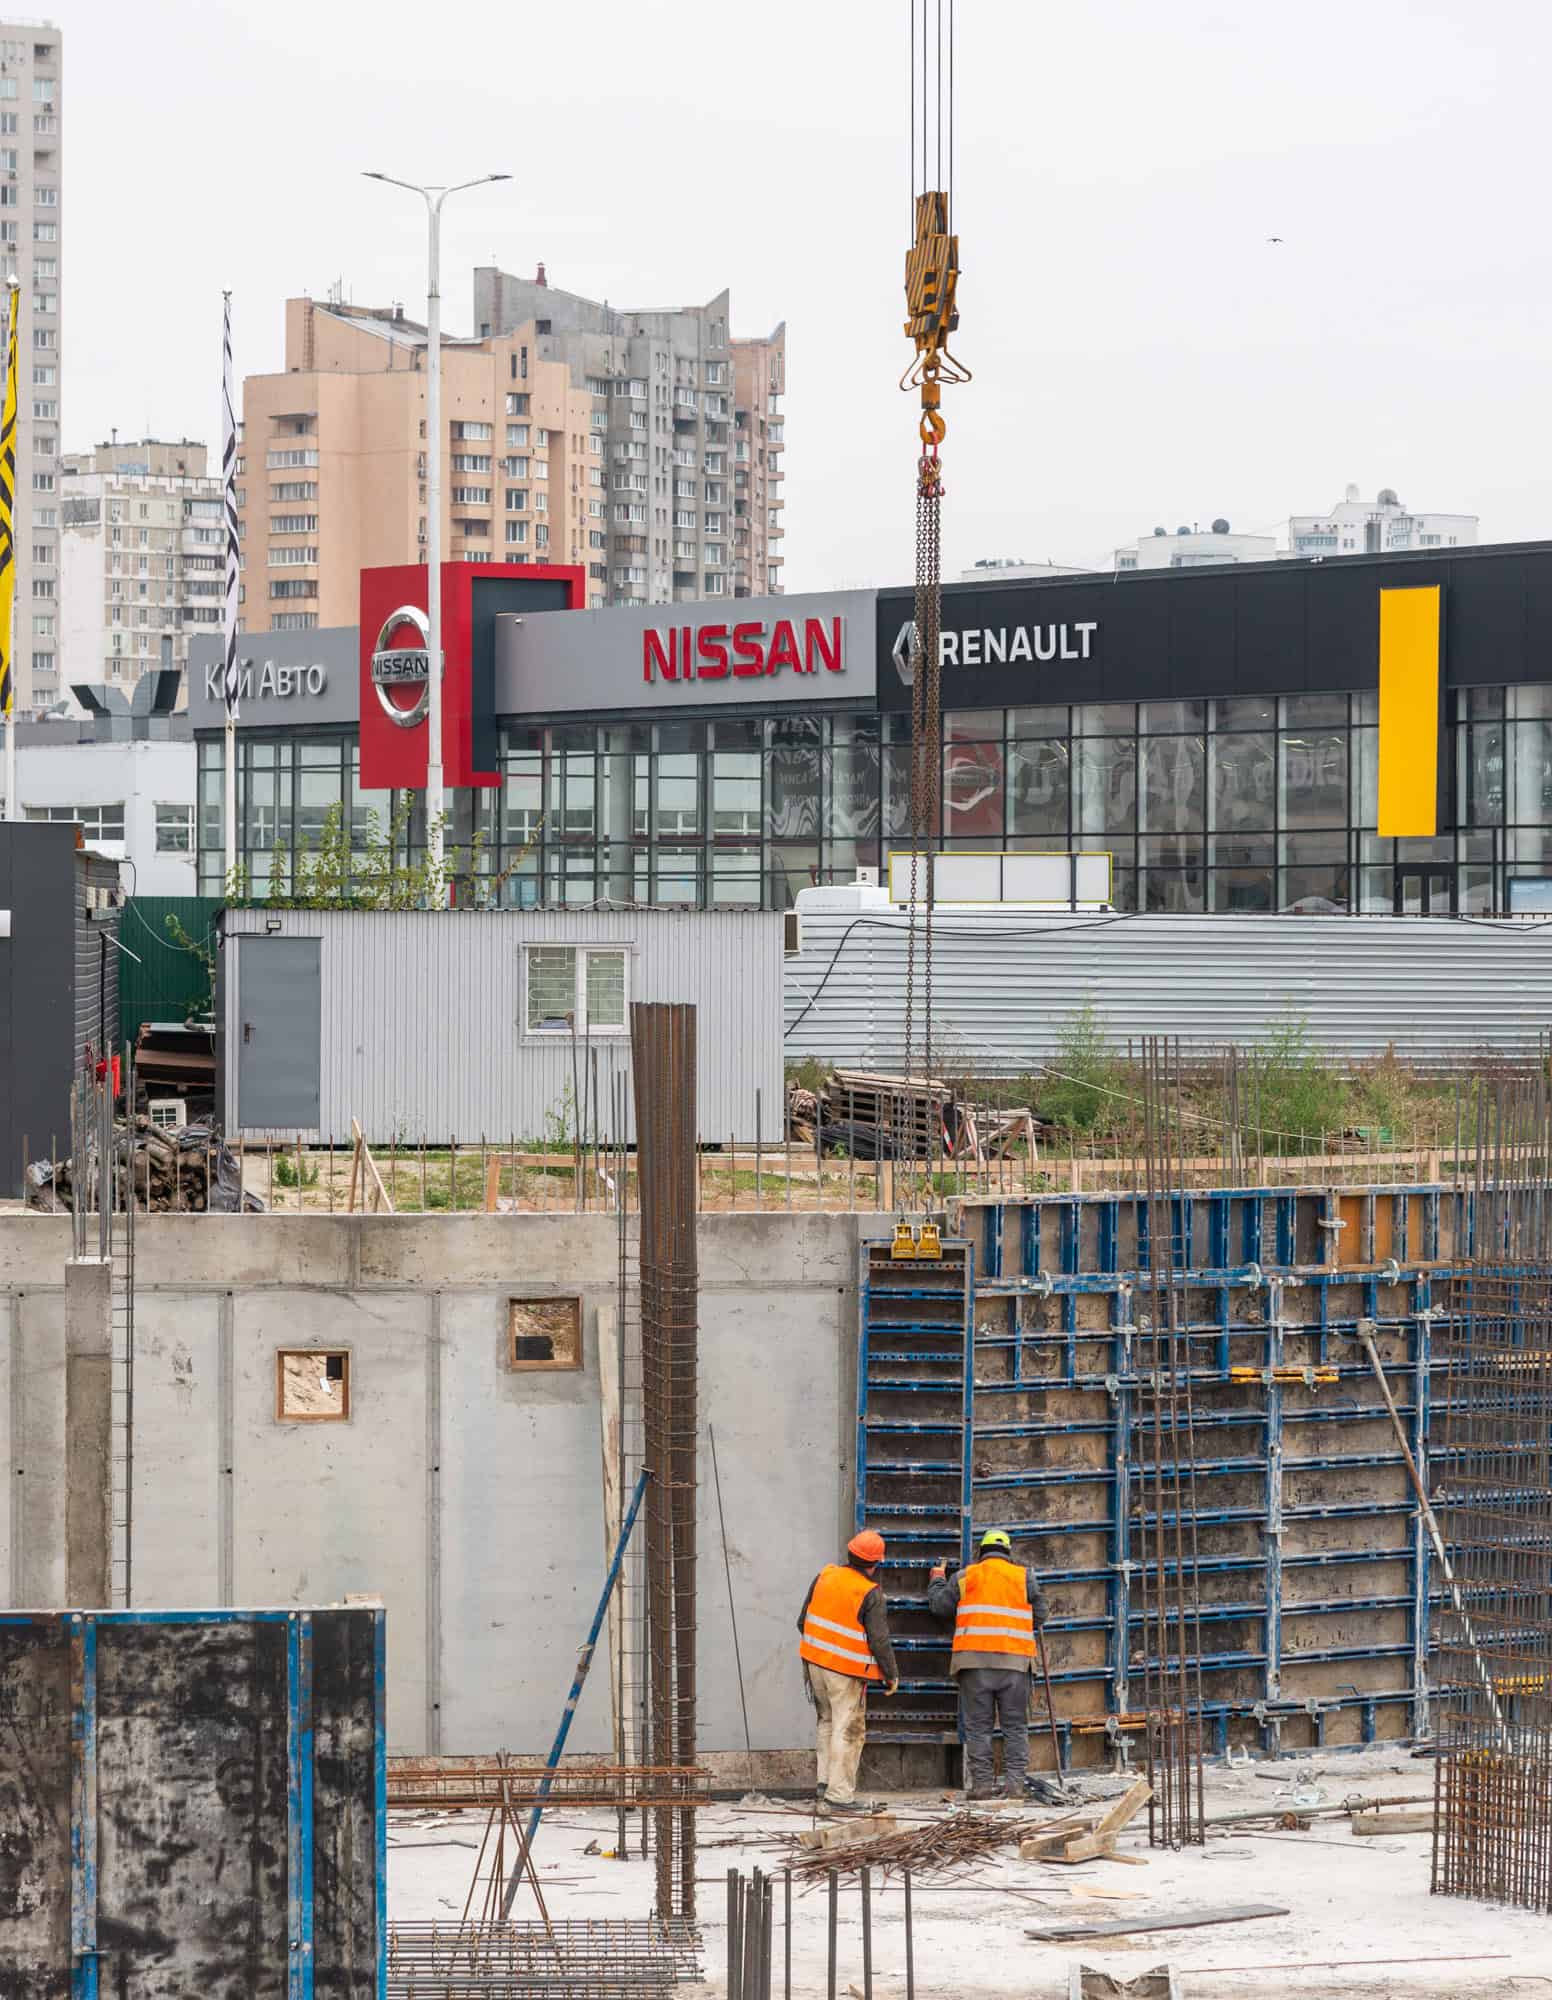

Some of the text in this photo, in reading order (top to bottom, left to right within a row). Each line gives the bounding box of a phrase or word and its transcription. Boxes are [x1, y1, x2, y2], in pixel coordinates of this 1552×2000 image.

[644, 617, 843, 683] NISSAN
[938, 622, 1097, 667] RENAULT
[205, 658, 252, 699] Кй
